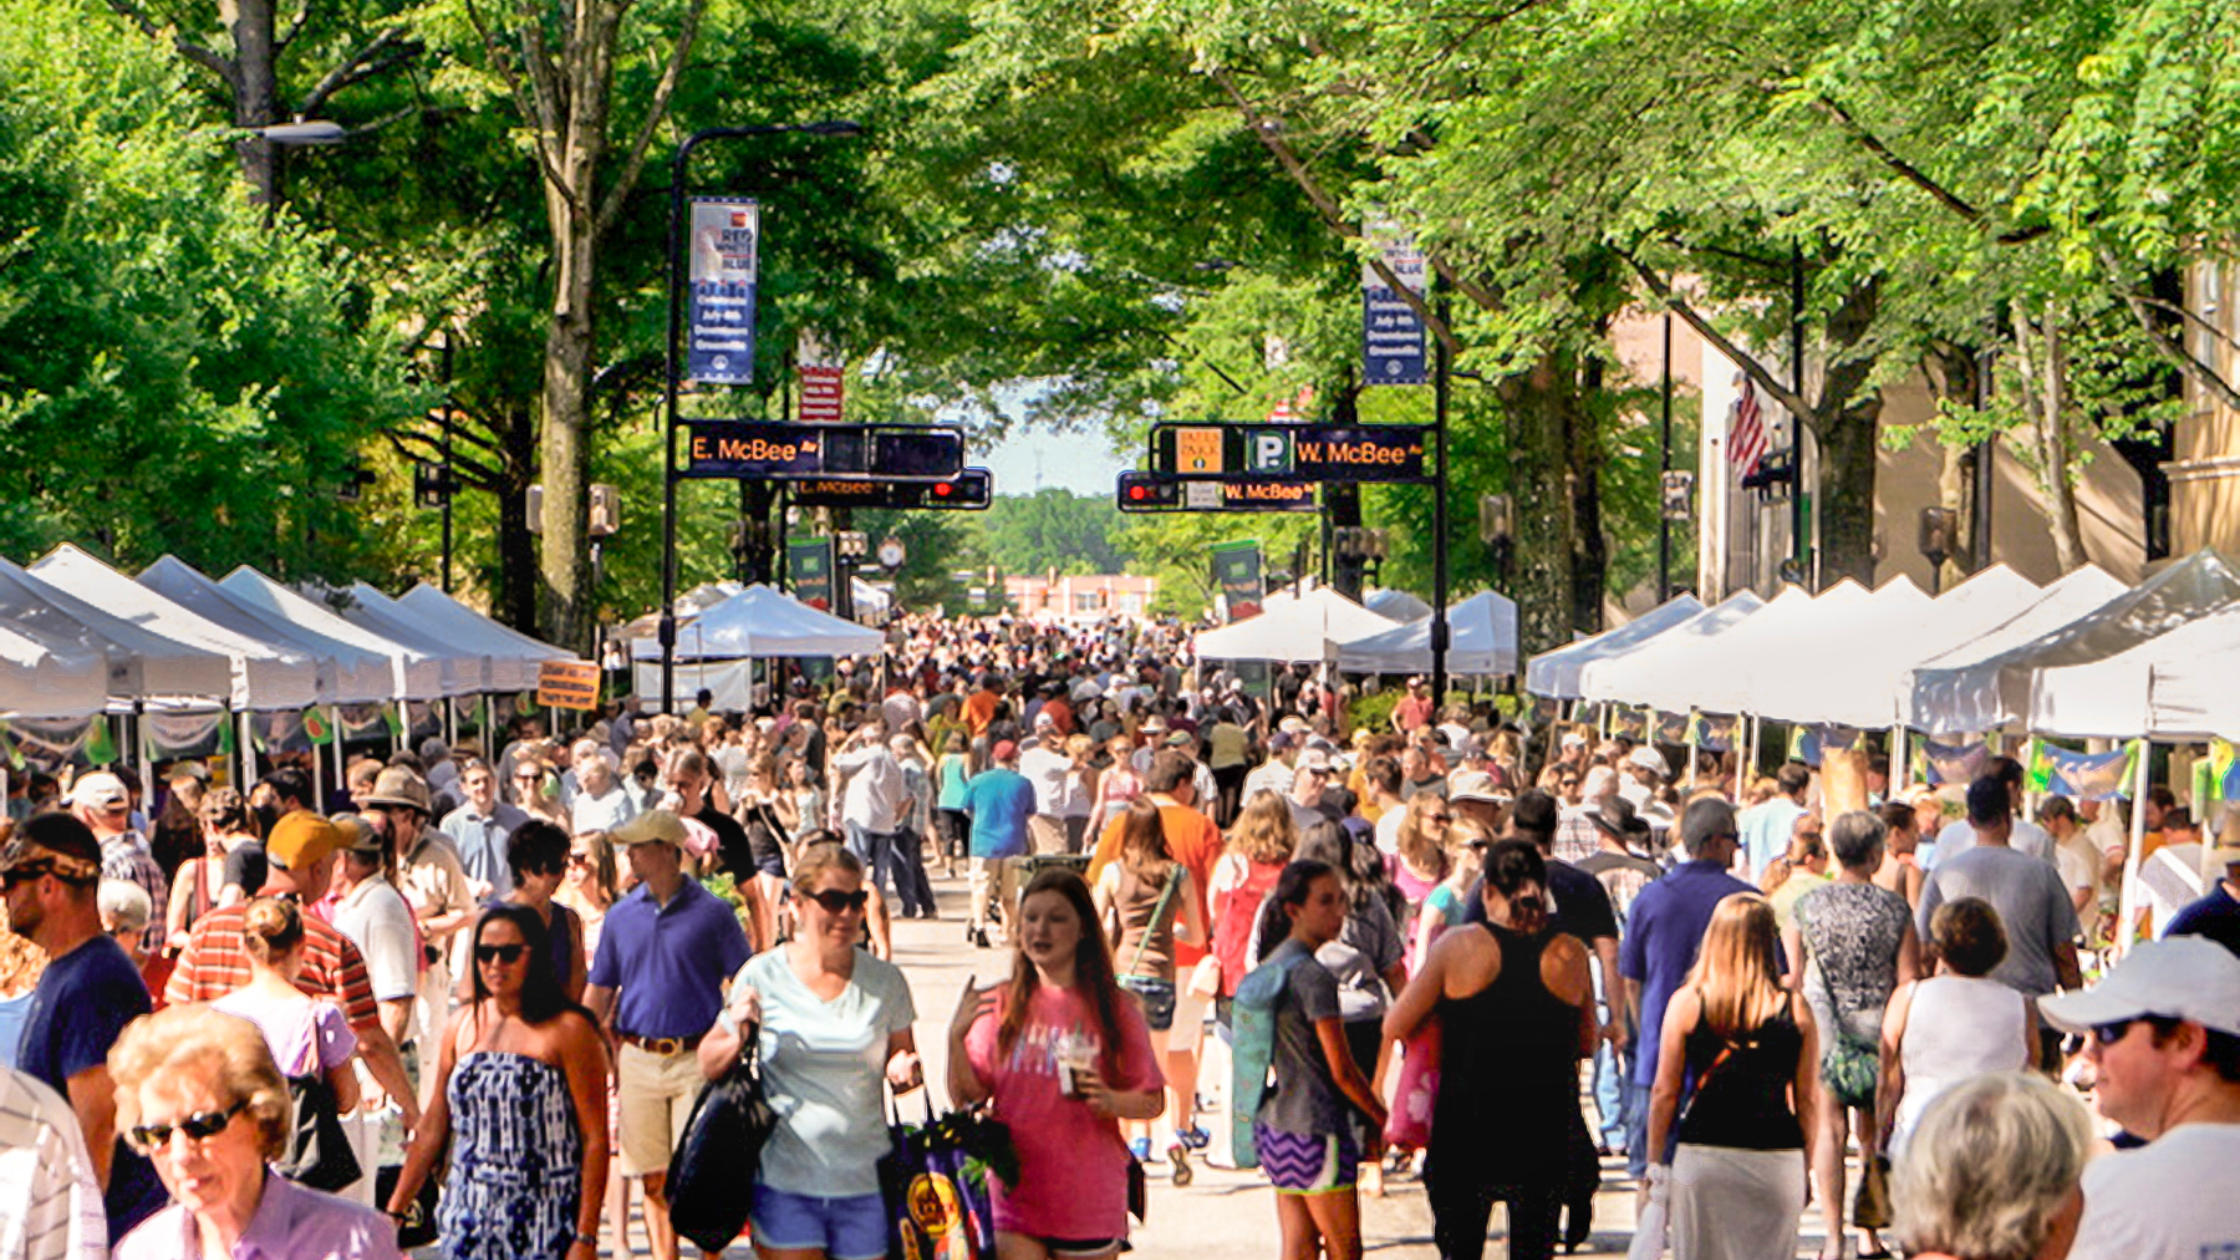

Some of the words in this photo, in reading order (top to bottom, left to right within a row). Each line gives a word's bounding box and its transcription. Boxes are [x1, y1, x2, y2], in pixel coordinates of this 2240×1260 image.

[1374, 315, 1394, 328] July
[693, 437, 713, 460] E.
[718, 438, 796, 462] McBee
[1297, 442, 1323, 463] W.
[1328, 441, 1405, 465] McBee
[1225, 484, 1244, 499] W.
[1247, 483, 1302, 500] McBee
